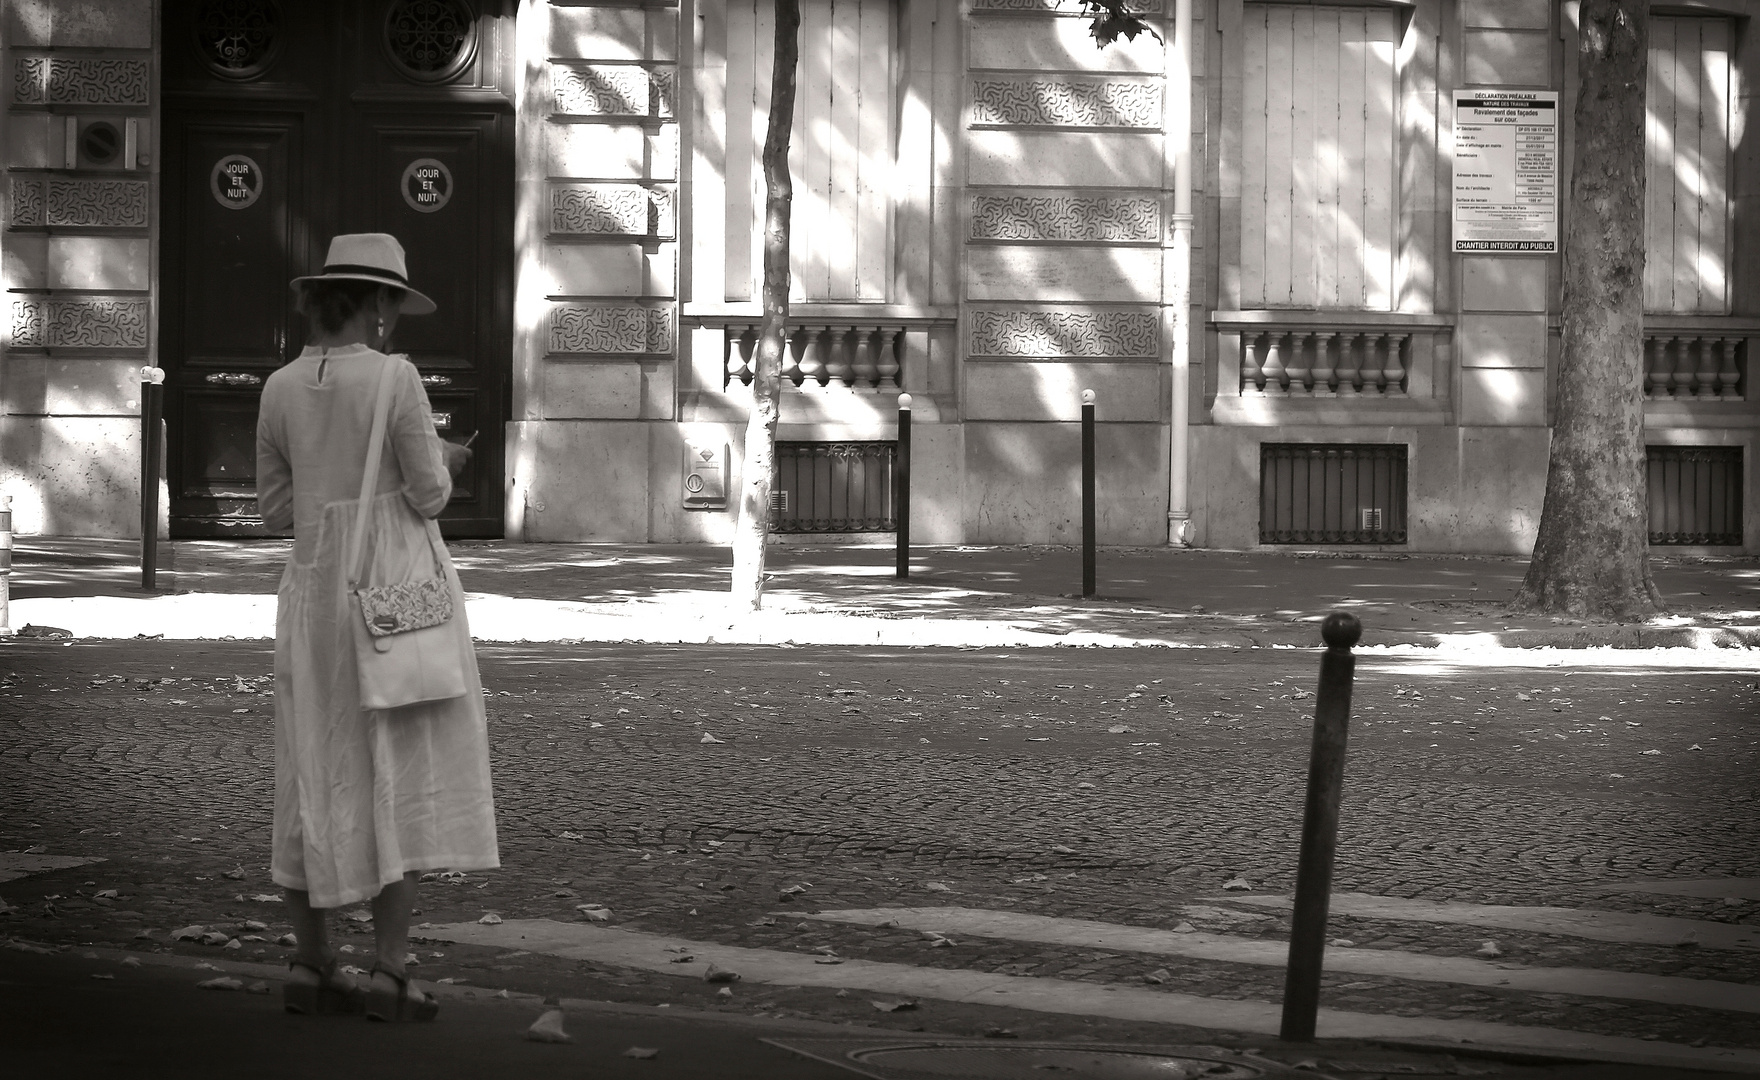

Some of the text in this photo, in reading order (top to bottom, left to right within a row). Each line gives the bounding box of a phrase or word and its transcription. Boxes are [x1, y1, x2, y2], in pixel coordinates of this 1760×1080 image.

[1473, 108, 1506, 116] Ravalement
[1517, 109, 1538, 118] façades
[226, 164, 249, 173] JOUR
[416, 169, 439, 178] JOUR
[232, 176, 243, 186] ET
[422, 181, 434, 190] ET
[227, 188, 247, 198] NUIT
[417, 193, 437, 202] NUIT
[1457, 241, 1553, 250] CHANTIER INTERDIT AU PUBLIC
